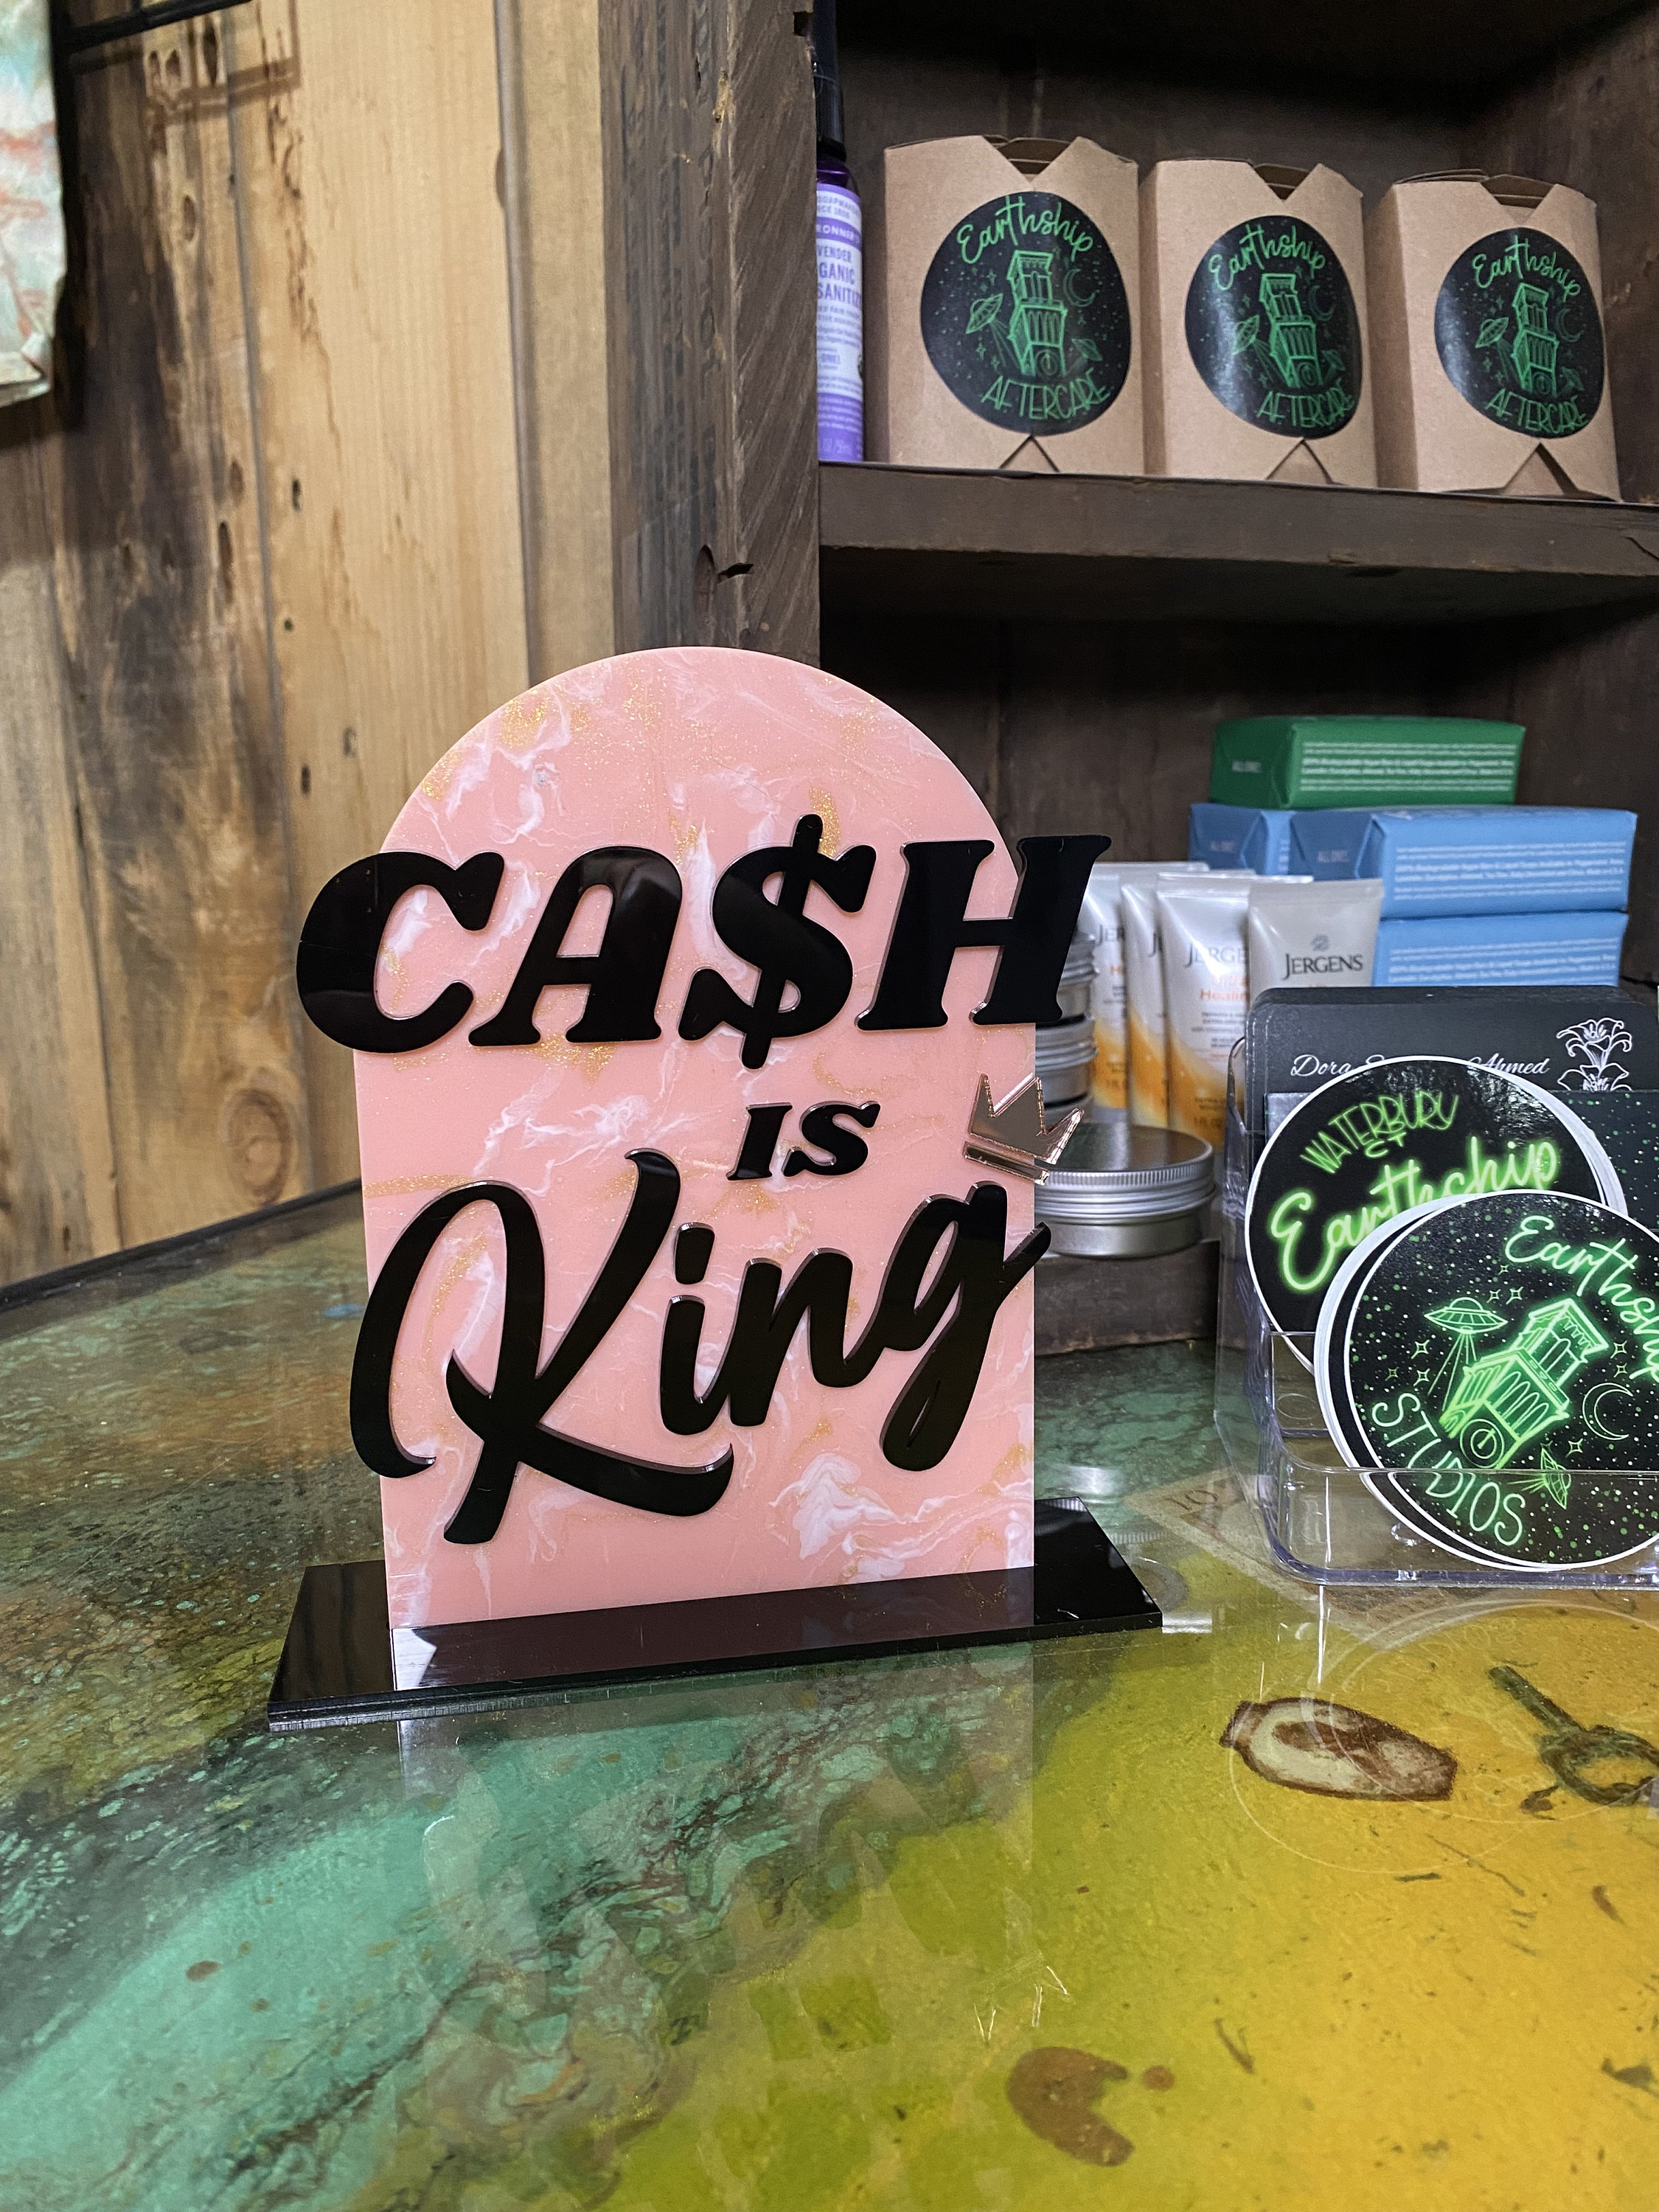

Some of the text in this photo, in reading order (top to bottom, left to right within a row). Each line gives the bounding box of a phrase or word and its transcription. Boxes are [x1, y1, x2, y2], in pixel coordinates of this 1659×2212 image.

[818, 246, 852, 262] VENDER
[956, 194, 1093, 264] Earthship
[819, 262, 855, 285] GANIC
[1208, 223, 1326, 291] Earthship
[1472, 234, 1581, 302] Earthship
[818, 282, 861, 308] SANITIZ
[980, 367, 1111, 420] AFTERCARE
[1256, 377, 1354, 428] AFTERCARE
[1485, 388, 1589, 434] AFTERCARE
[296, 814, 1110, 1070] CA$H
[1184, 943, 1245, 967] JERGE
[1282, 953, 1363, 980] JERGENS
[1290, 1054, 1354, 1077] Dora
[1300, 1091, 1458, 1173] WATERBURY
[1365, 1132, 1407, 1159] CT
[1504, 1215, 1659, 1383] Earthsh
[349, 1148, 1051, 1544] King
[1372, 1392, 1526, 1546] STUDIOS
